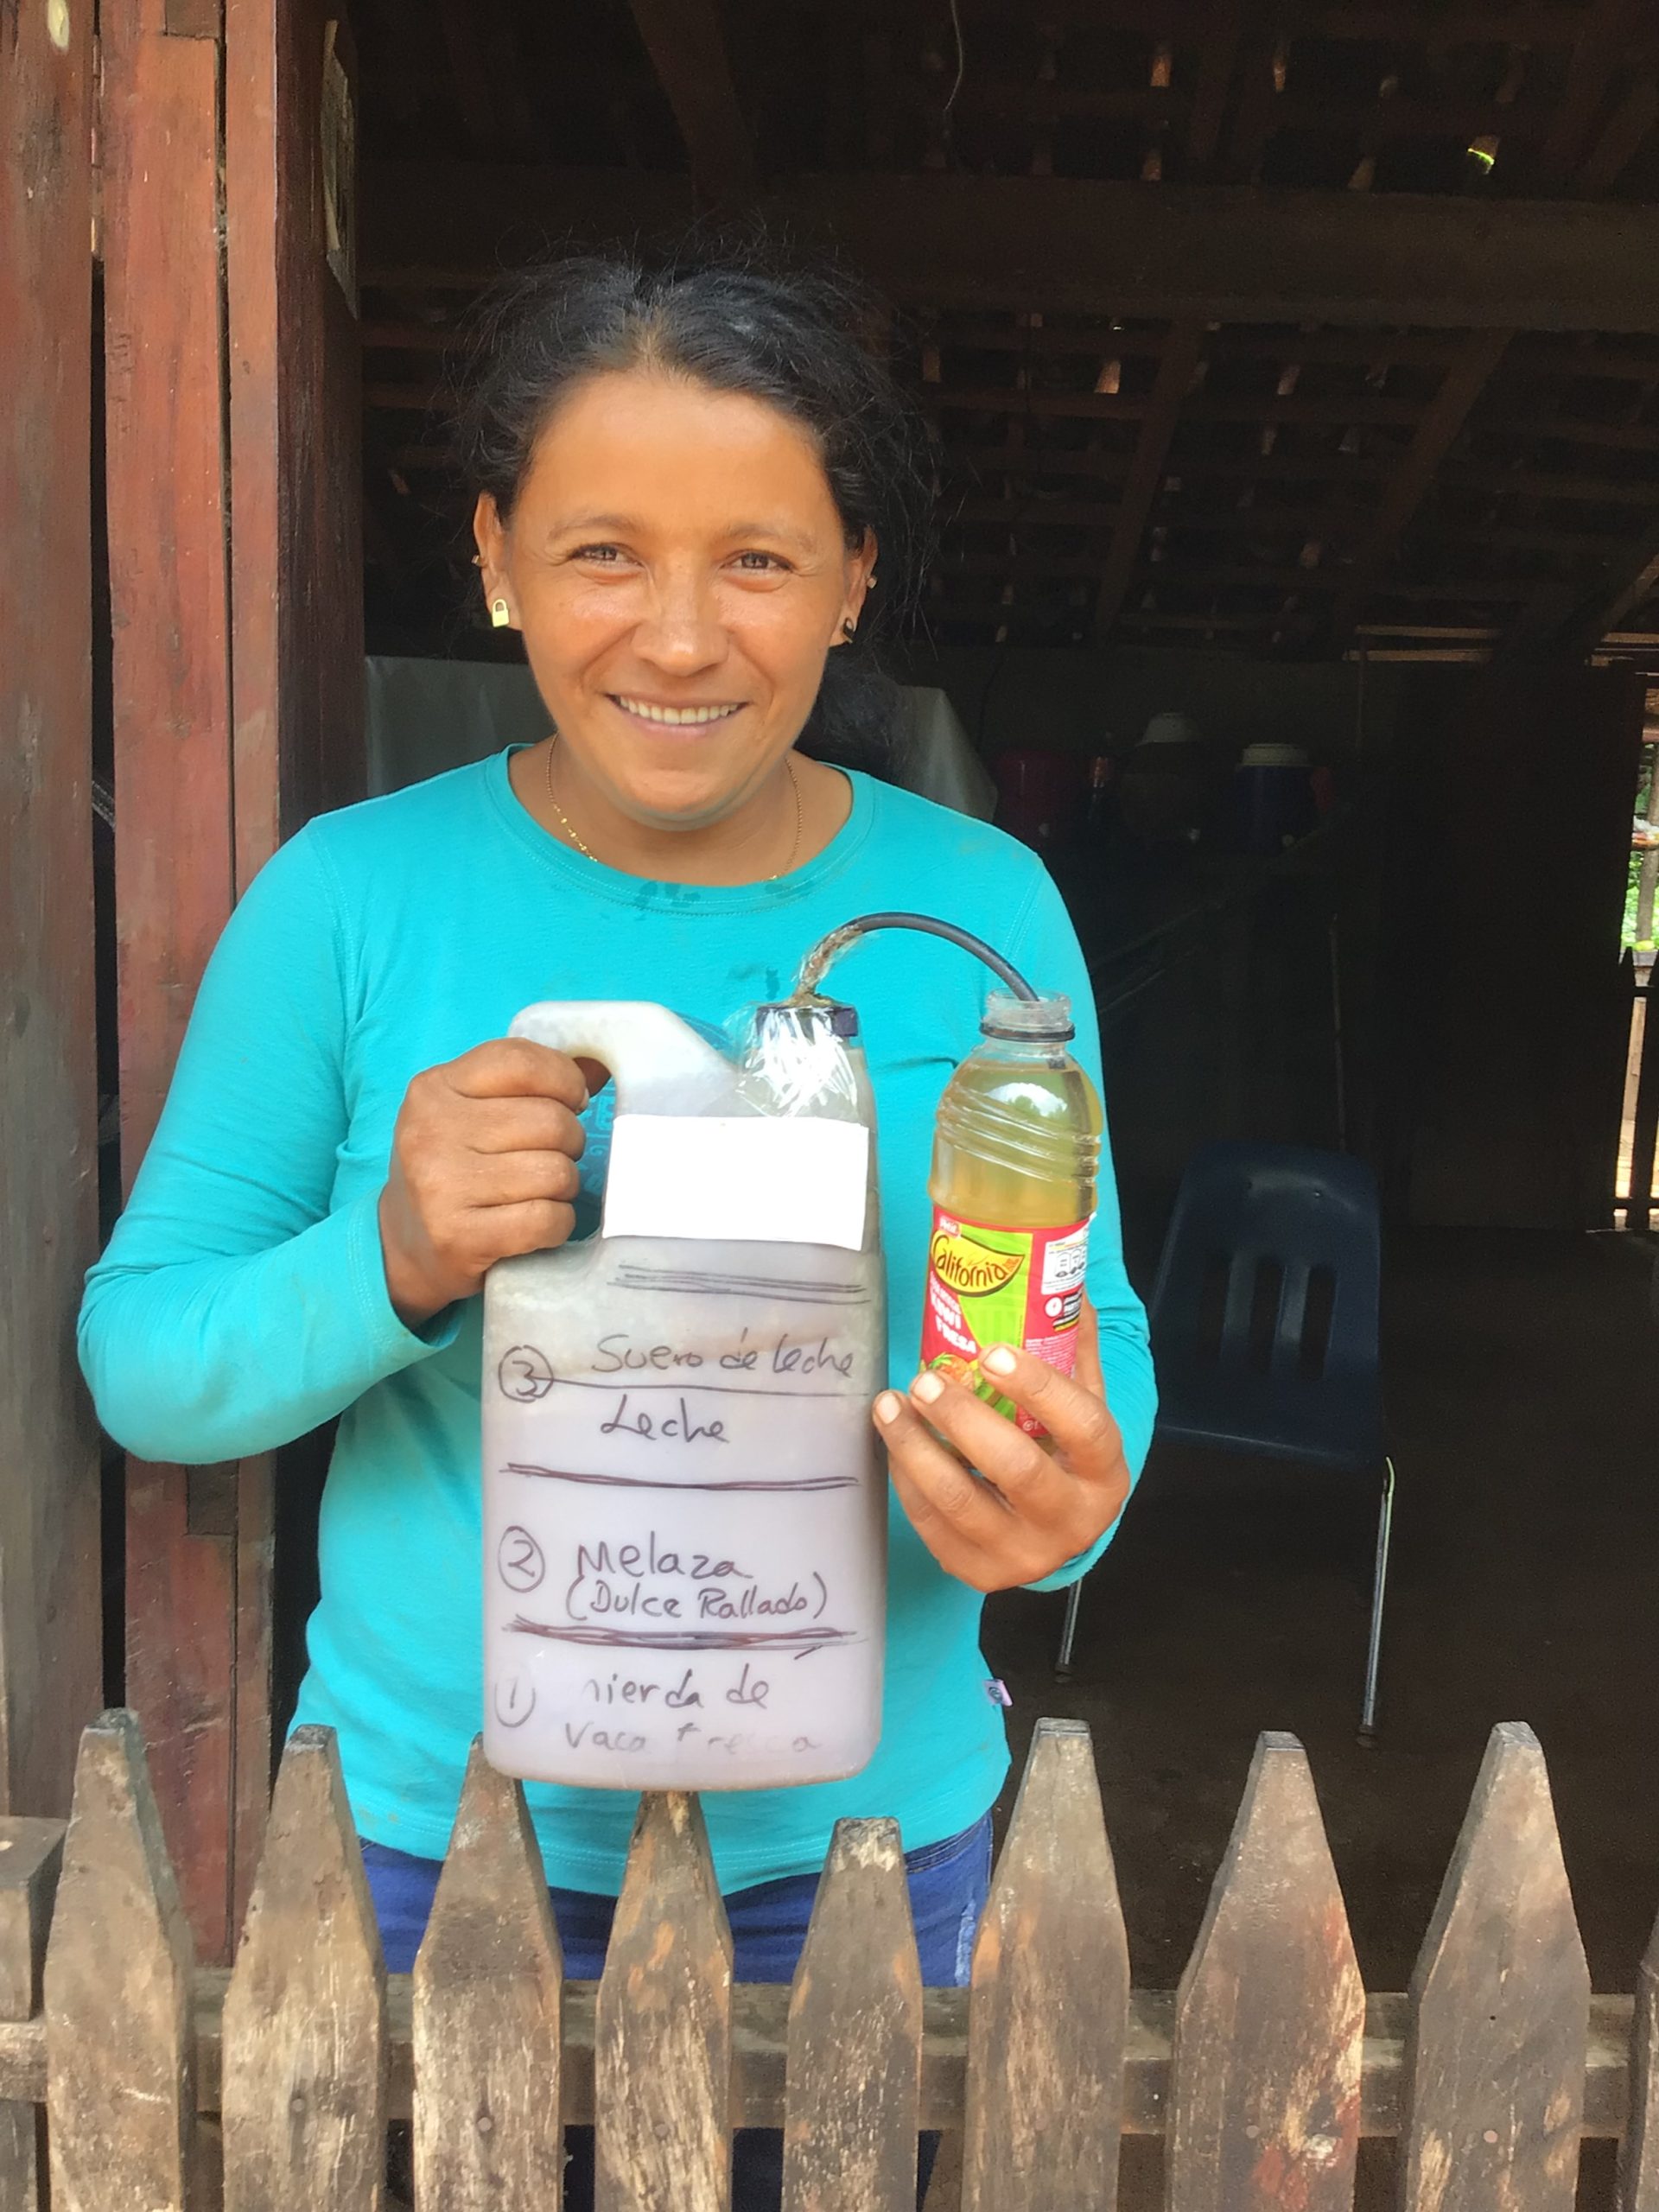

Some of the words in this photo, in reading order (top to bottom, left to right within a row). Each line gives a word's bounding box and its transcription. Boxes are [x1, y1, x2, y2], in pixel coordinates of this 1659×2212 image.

[932, 1234, 1008, 1287] California
[591, 1333, 704, 1372] Suero
[719, 1327, 759, 1371] de
[600, 1394, 730, 1444] Leche
[576, 1530, 754, 1580] Melaza
[565, 1573, 683, 1621] (Dulce
[696, 1571, 828, 1620] Rallado)
[725, 1662, 770, 1710] de
